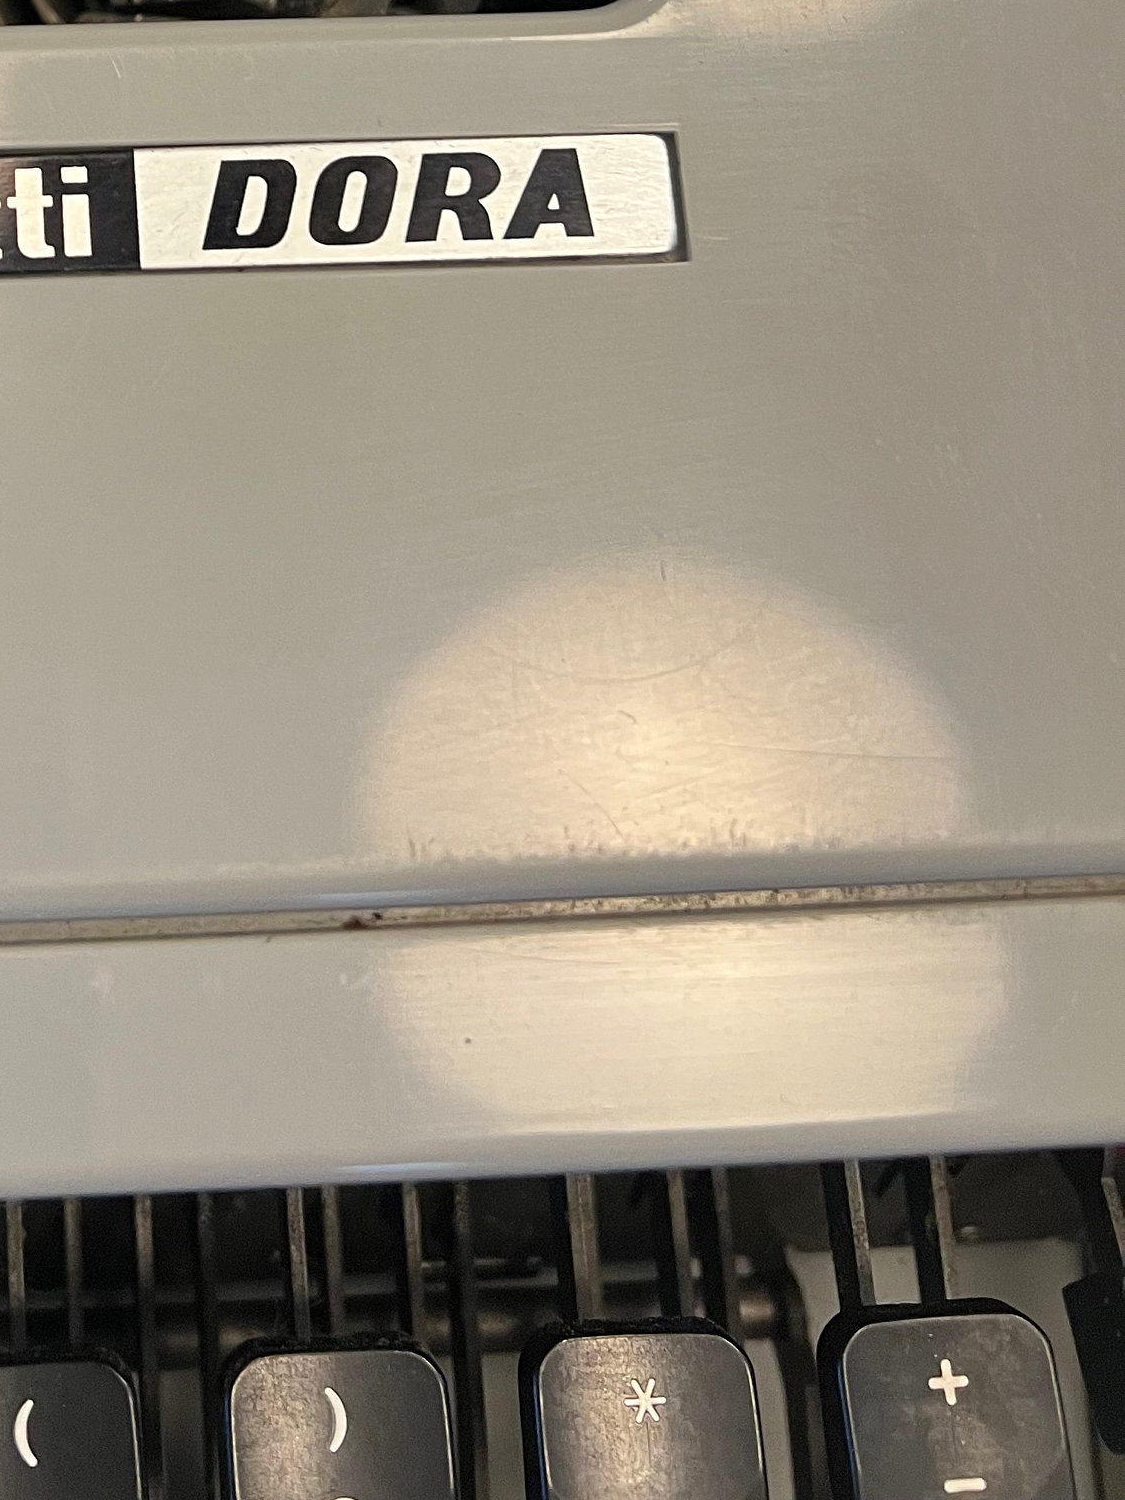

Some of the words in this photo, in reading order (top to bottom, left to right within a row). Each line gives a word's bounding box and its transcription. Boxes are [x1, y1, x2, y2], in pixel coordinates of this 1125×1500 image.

[202, 147, 595, 250] DORA
[928, 1358, 969, 1406] +
[14, 1399, 38, 1467] (
[324, 1387, 348, 1453] )
